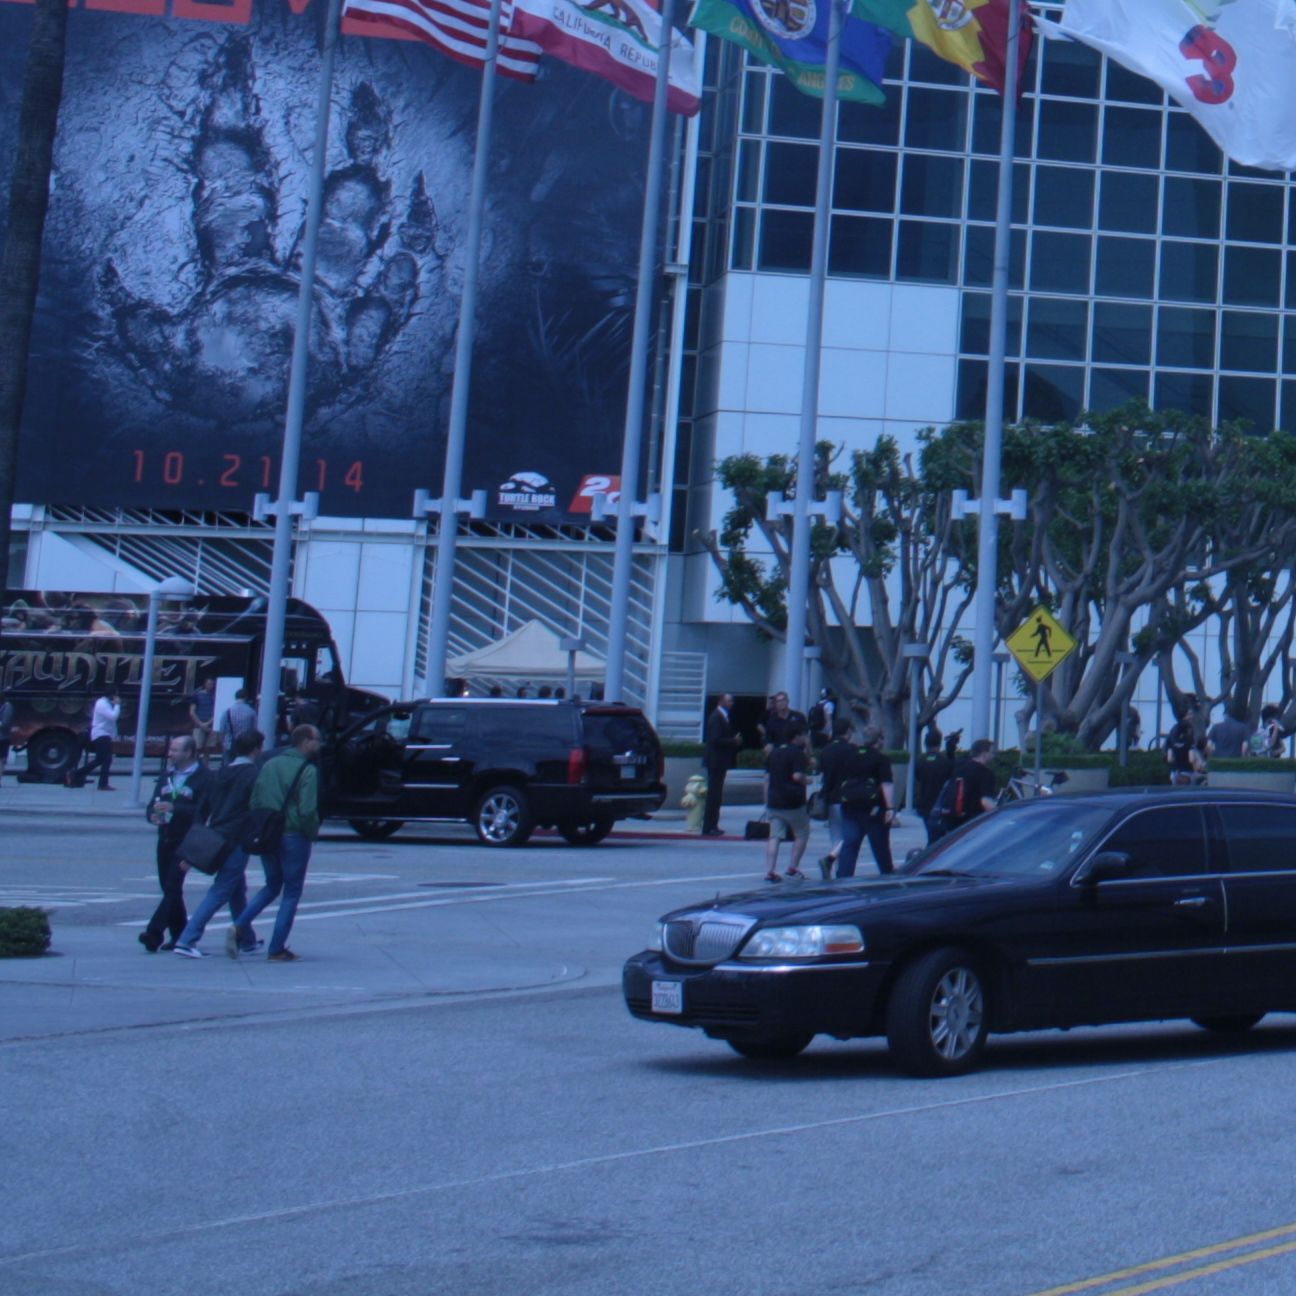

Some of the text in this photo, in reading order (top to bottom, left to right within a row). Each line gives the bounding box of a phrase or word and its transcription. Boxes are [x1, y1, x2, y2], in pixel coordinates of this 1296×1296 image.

[619, 42, 658, 71] REPUB
[498, 493, 555, 506] TURTLE ROCK
[0, 649, 217, 696] AUNTLET
